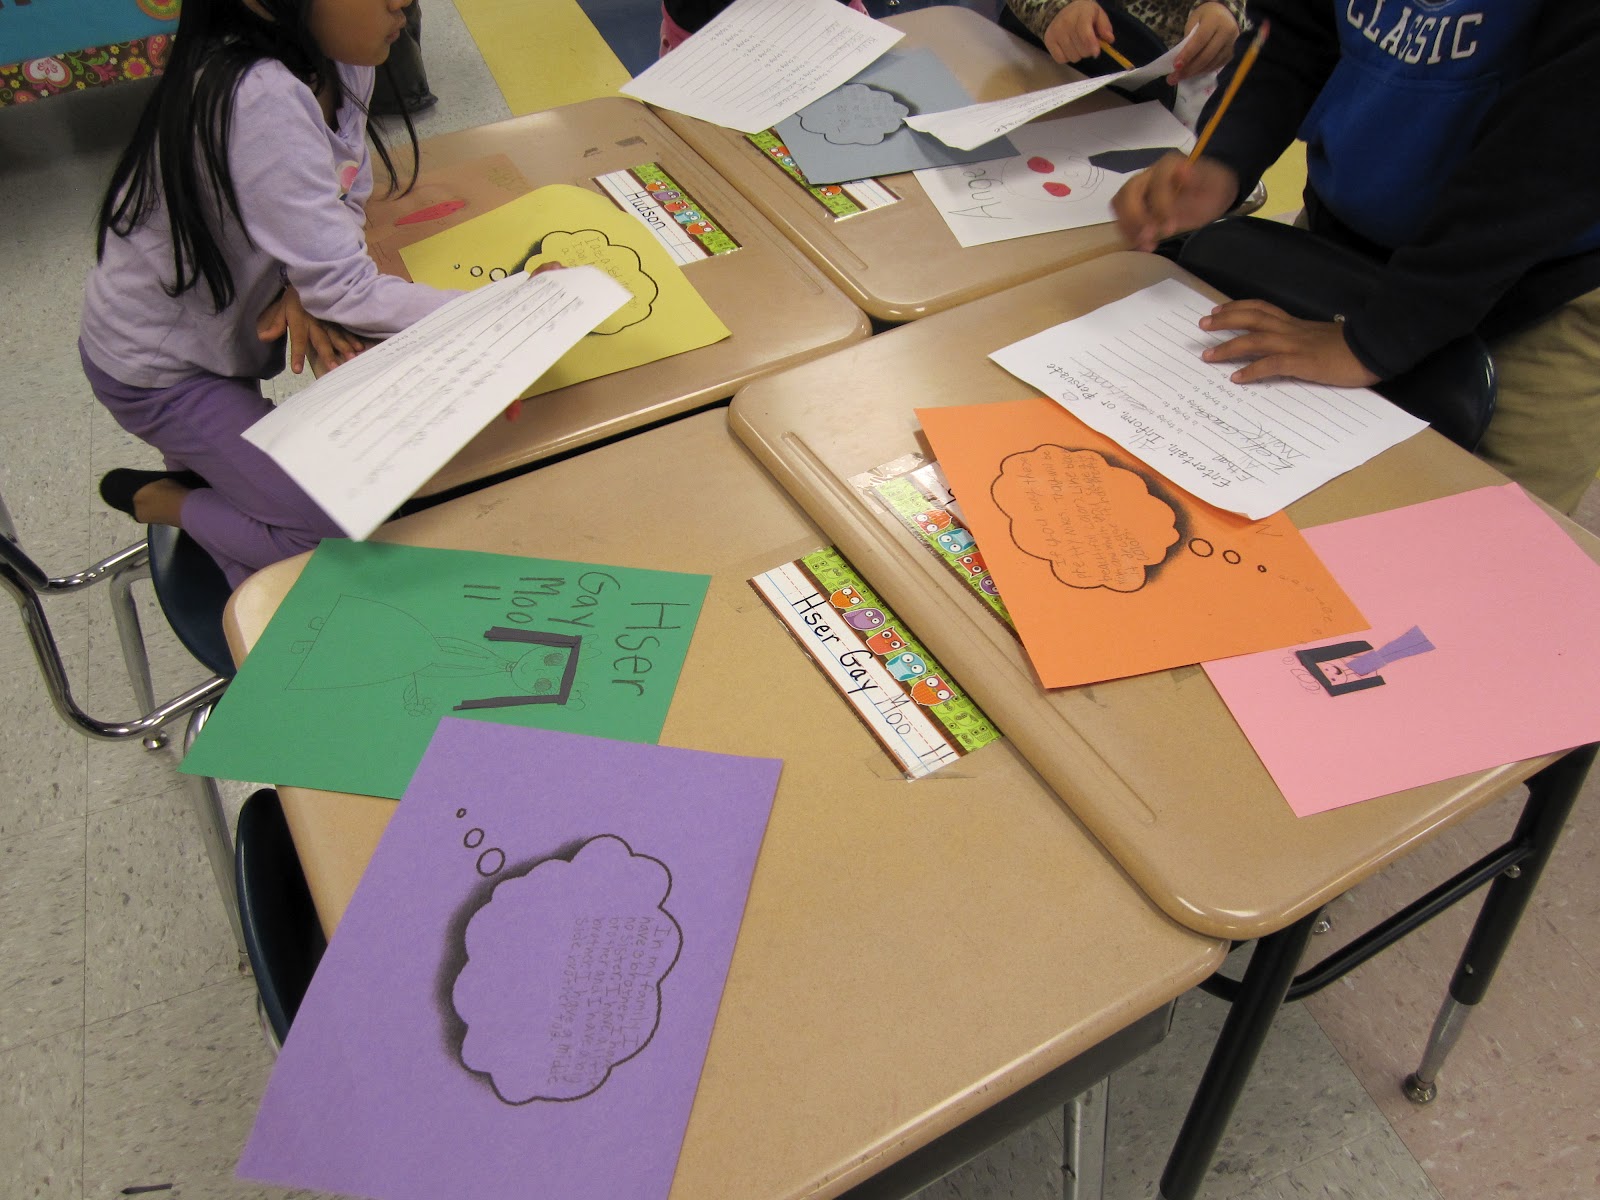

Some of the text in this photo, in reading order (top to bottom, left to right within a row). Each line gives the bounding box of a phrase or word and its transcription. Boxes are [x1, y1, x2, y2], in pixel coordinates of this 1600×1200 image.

[1347, 0, 1483, 65] CLASSIC
[625, 190, 666, 231] Hudson
[1046, 361, 1098, 401] Persuade
[1201, 391, 1220, 405] trying
[1100, 399, 1115, 409] or
[506, 577, 566, 624] Moo
[547, 571, 621, 628] Gay
[611, 602, 690, 697] Hser
[792, 592, 840, 643] Hser
[839, 649, 879, 694] Gay
[874, 692, 911, 735] Moo
[622, 915, 636, 931] no
[634, 915, 654, 947] have
[605, 983, 620, 996] I
[622, 924, 672, 1048] In my family I
